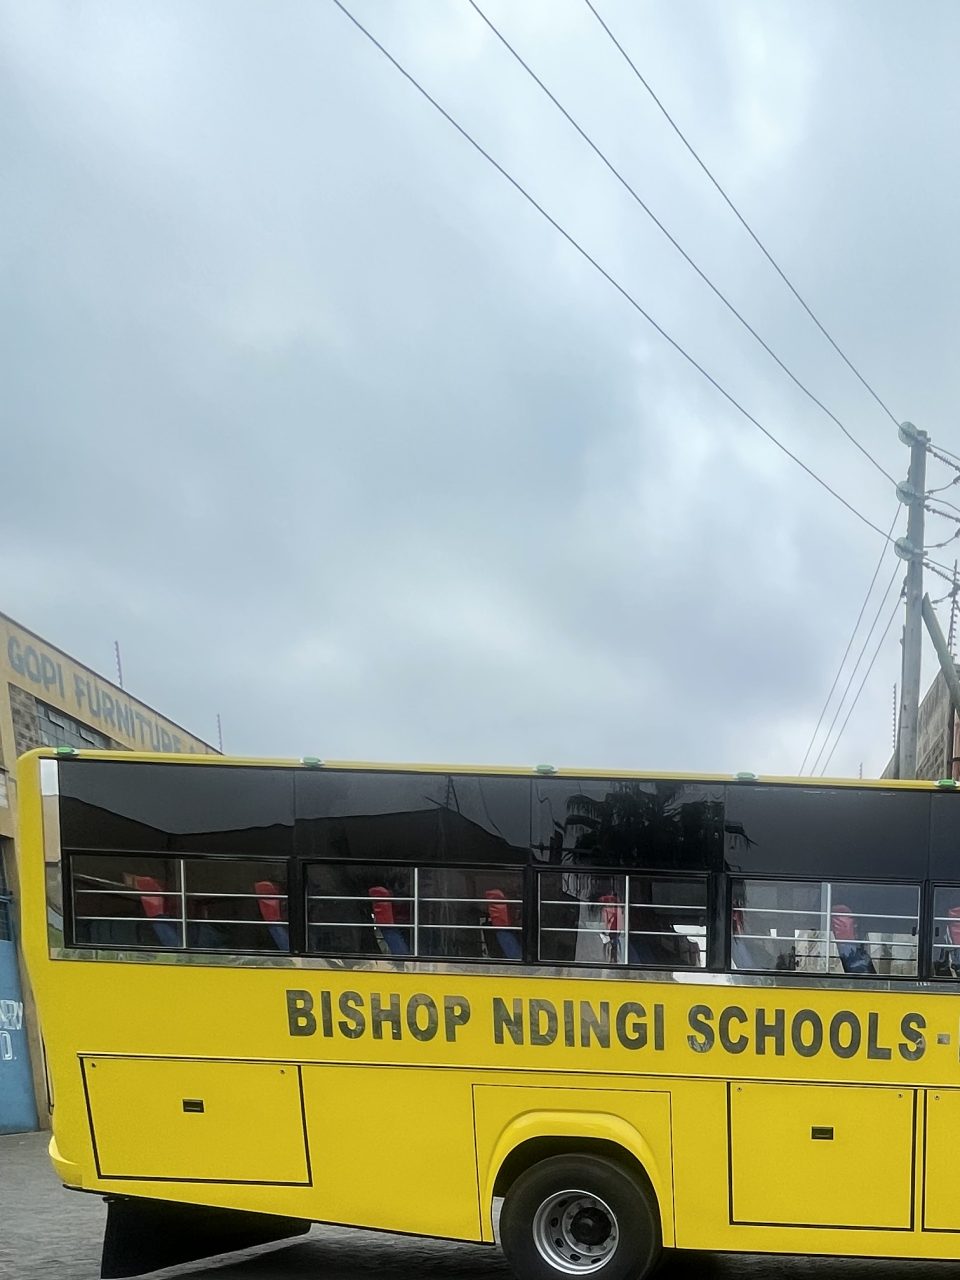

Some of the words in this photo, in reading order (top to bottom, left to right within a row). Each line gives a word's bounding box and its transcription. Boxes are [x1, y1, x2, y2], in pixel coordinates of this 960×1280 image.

[7, 635, 65, 698] GOPI
[285, 989, 471, 1042] BISHOP
[493, 997, 665, 1051] NDINGI
